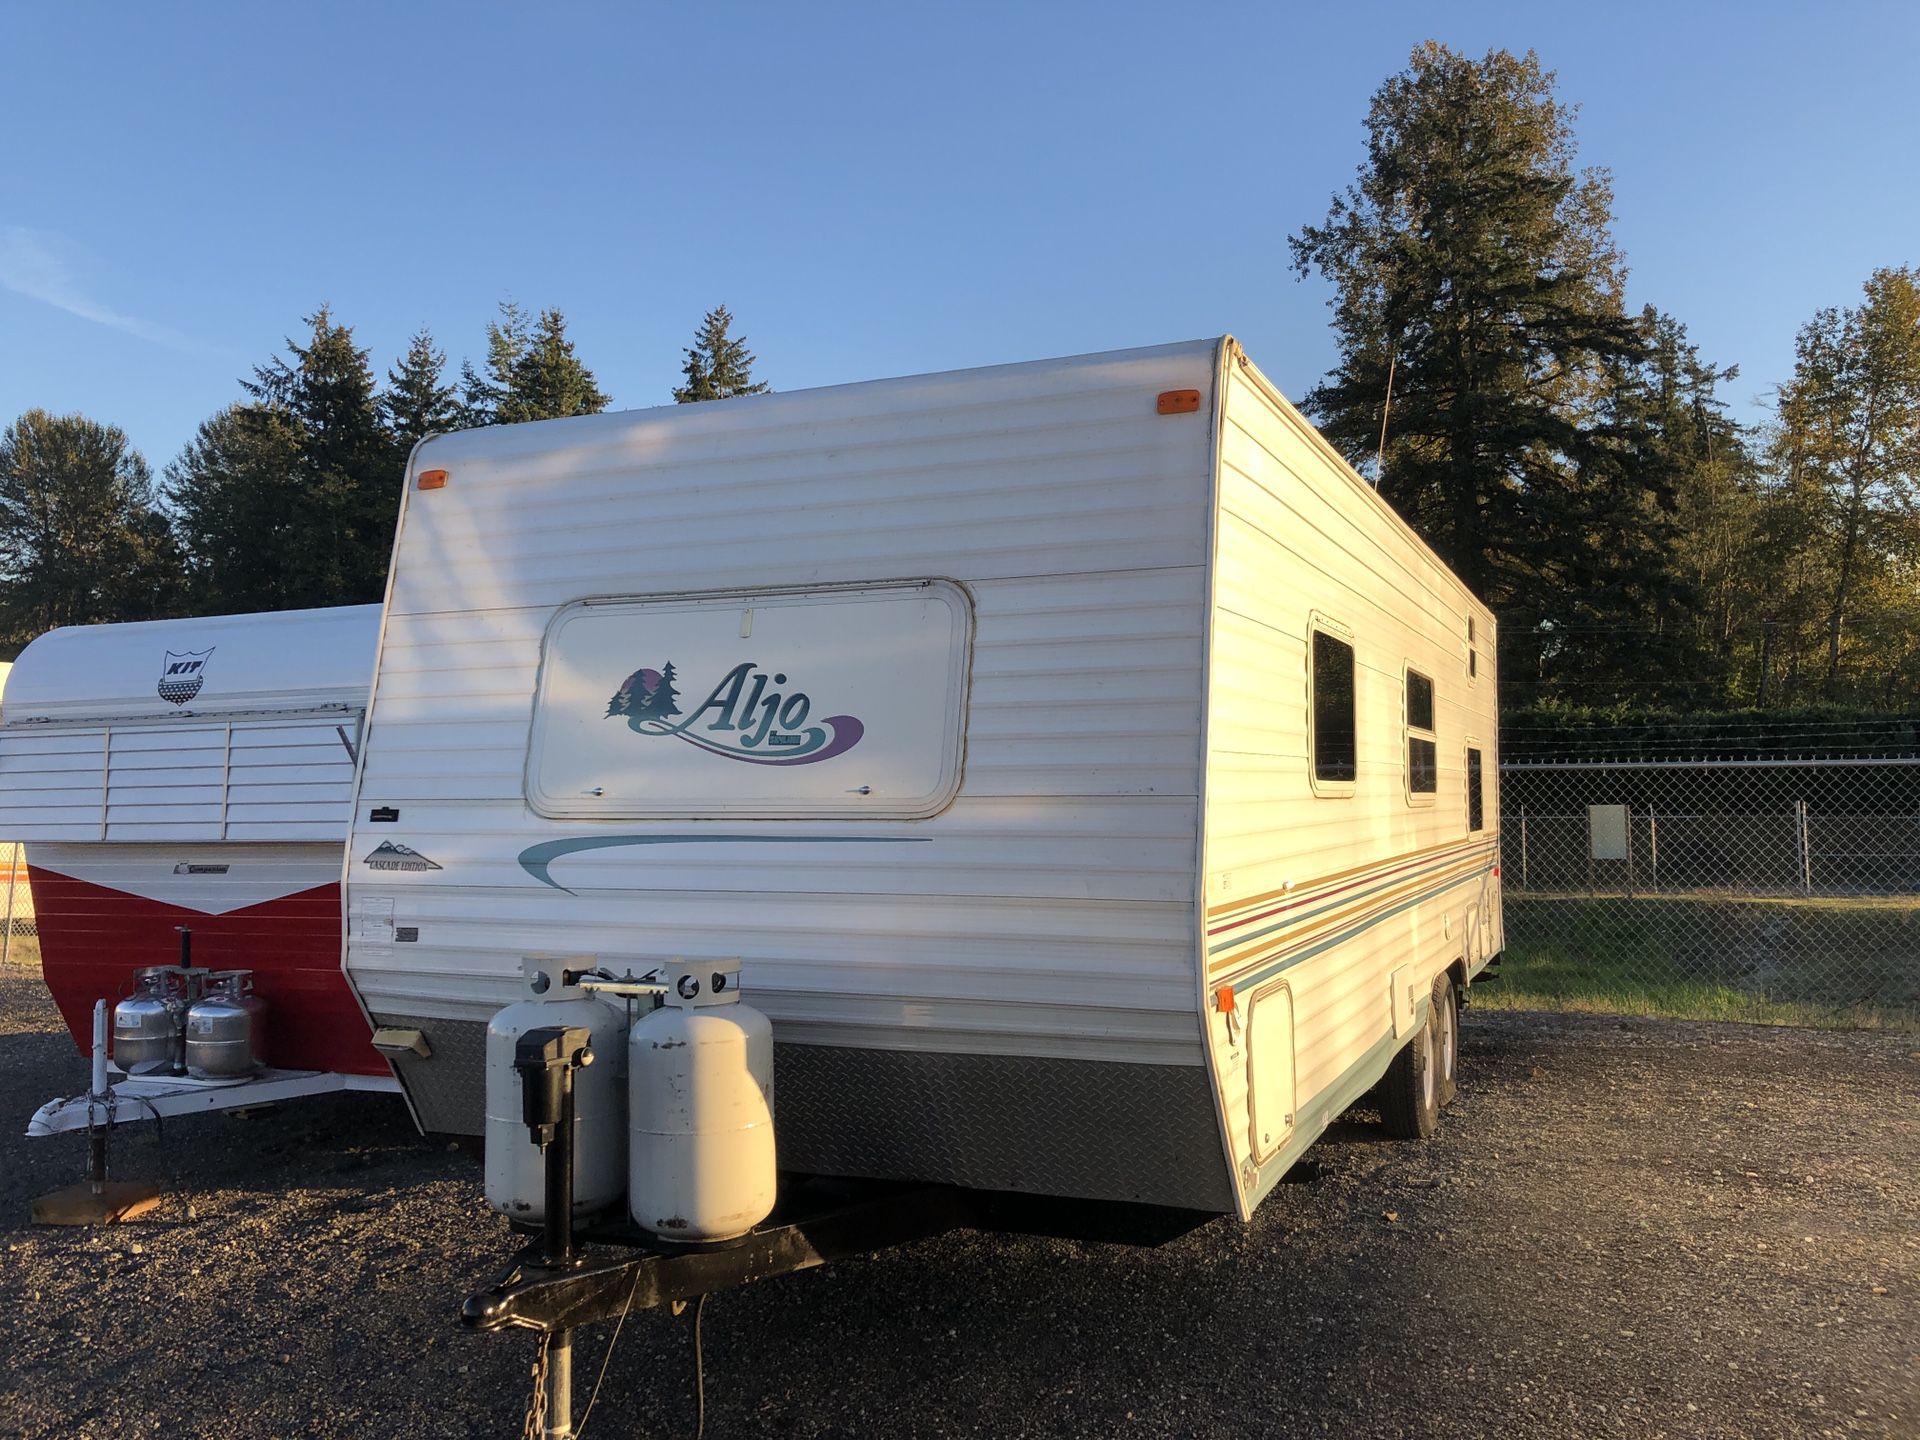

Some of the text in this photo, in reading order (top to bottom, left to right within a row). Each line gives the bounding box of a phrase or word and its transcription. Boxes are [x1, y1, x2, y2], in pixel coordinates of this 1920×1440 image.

[166, 660, 203, 675] KIT
[682, 662, 810, 748] Aljo
[369, 860, 427, 872] CASCADE EDITION
